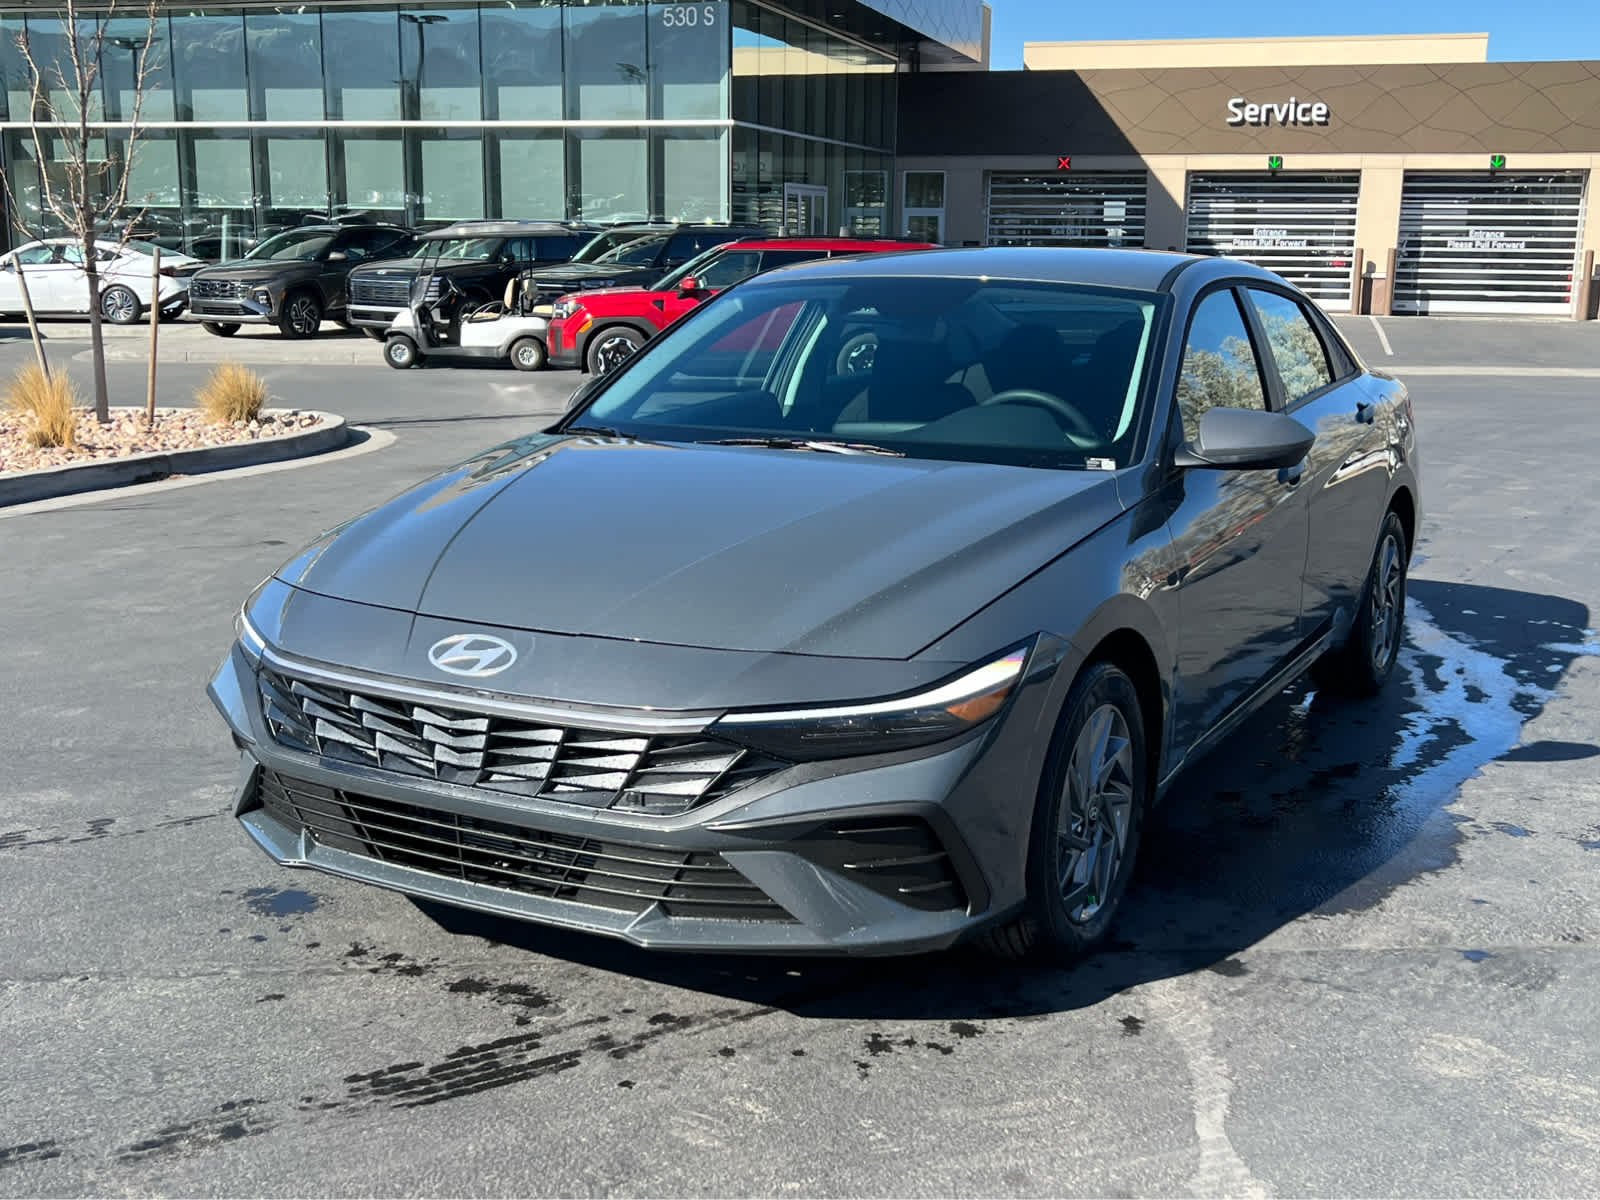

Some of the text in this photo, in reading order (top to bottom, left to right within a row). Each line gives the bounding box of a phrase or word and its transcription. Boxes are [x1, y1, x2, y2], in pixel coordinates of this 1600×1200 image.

[663, 6, 715, 27] 530 S
[1226, 96, 1329, 124] Service
